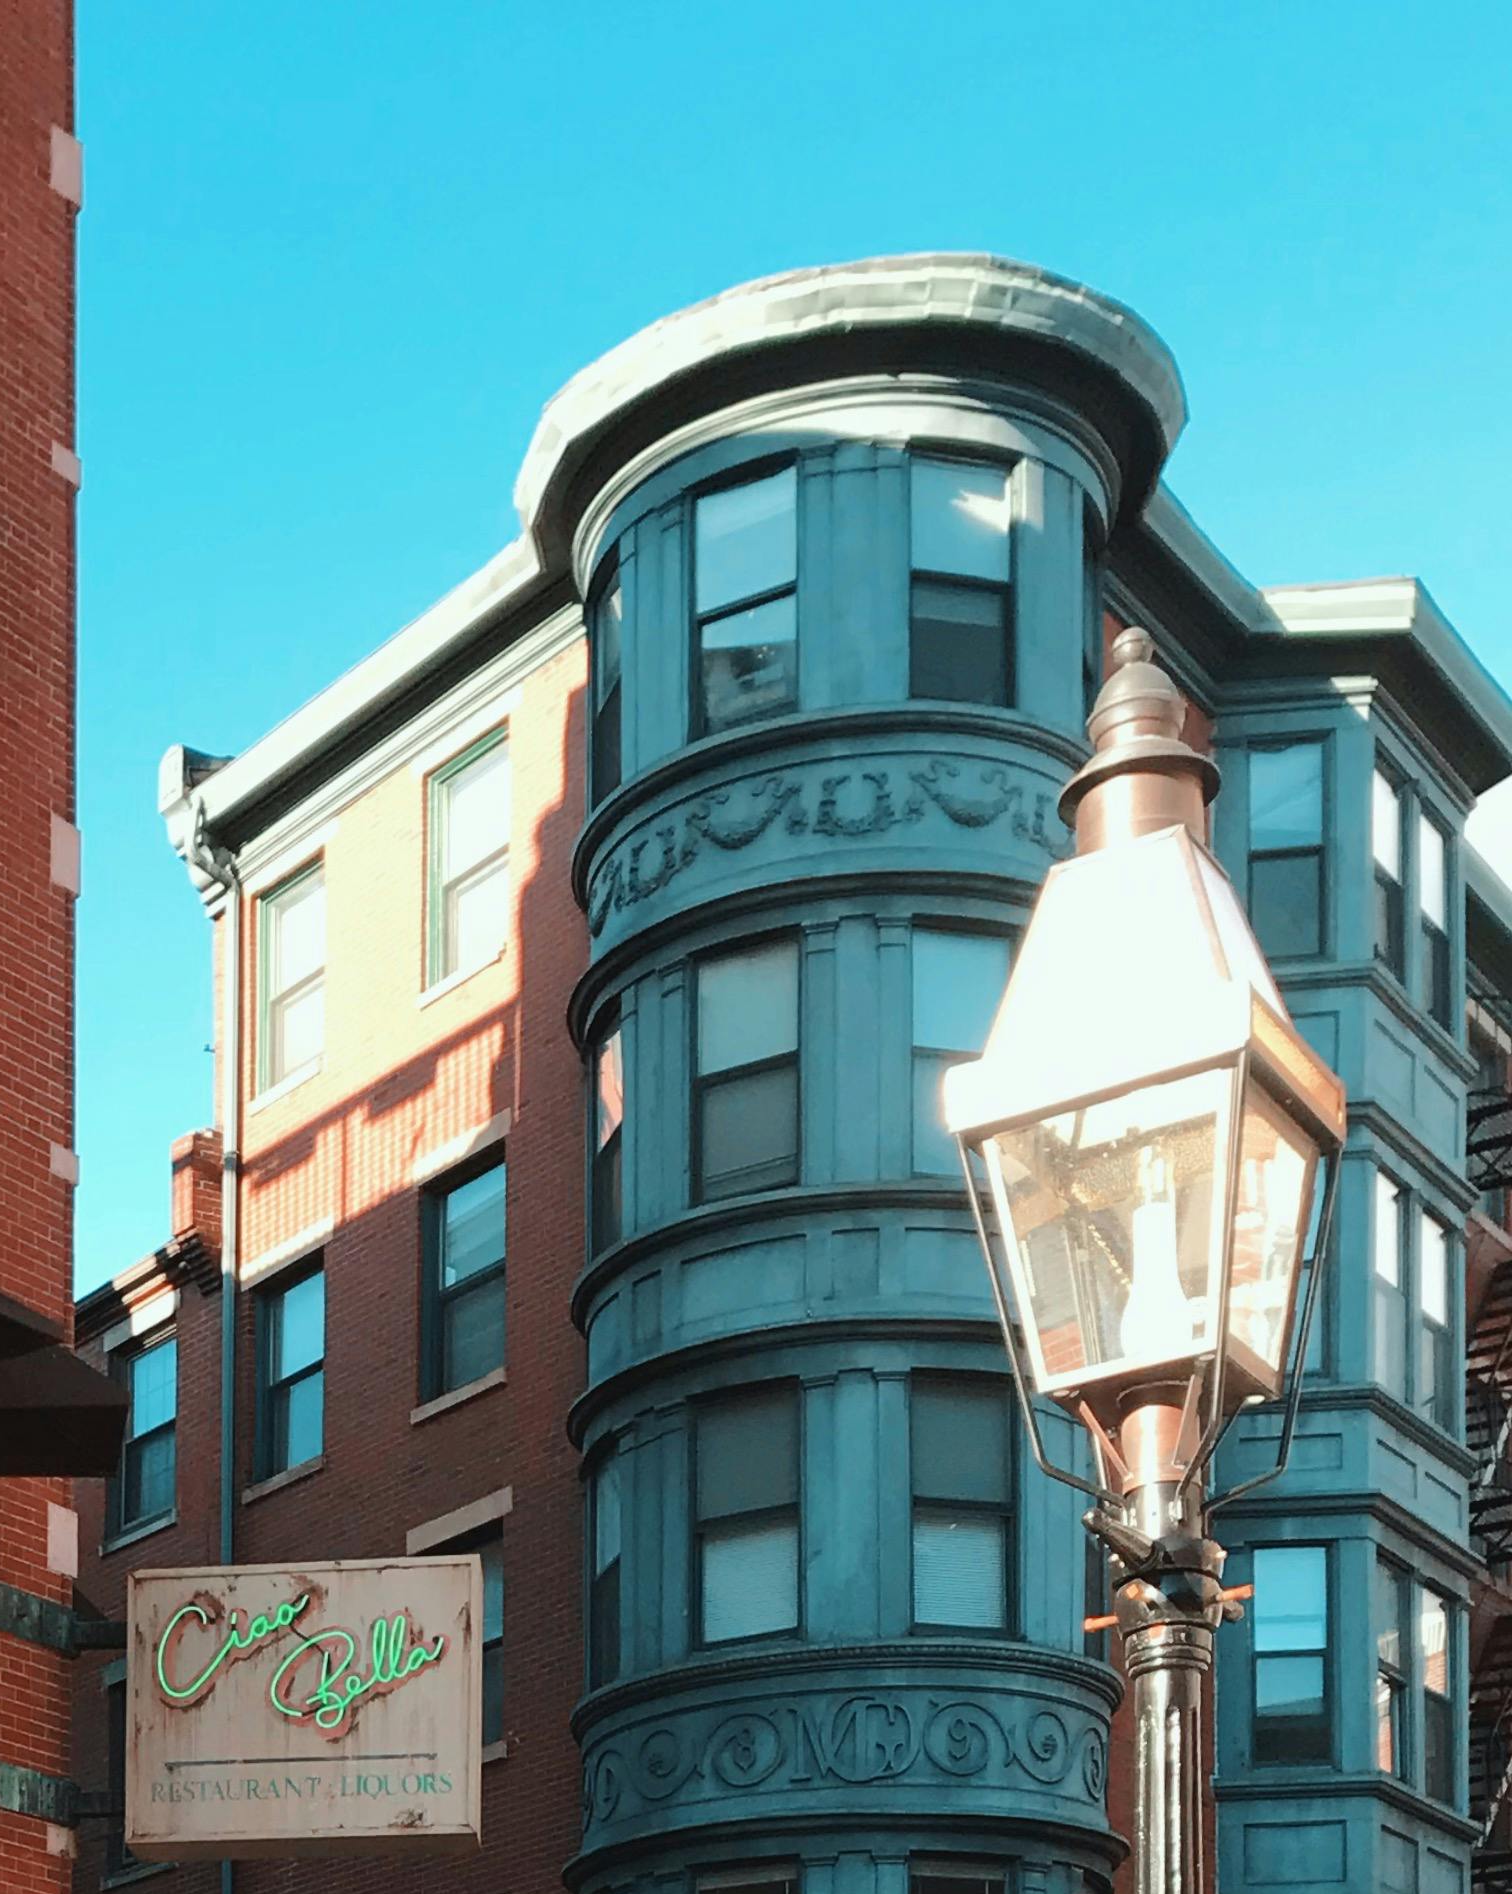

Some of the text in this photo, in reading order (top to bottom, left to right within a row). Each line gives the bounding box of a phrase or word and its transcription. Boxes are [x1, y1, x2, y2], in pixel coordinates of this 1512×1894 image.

[156, 1593, 445, 1729] Ciao Bella
[151, 1772, 454, 1803] RESTAURANT LIQUORS
